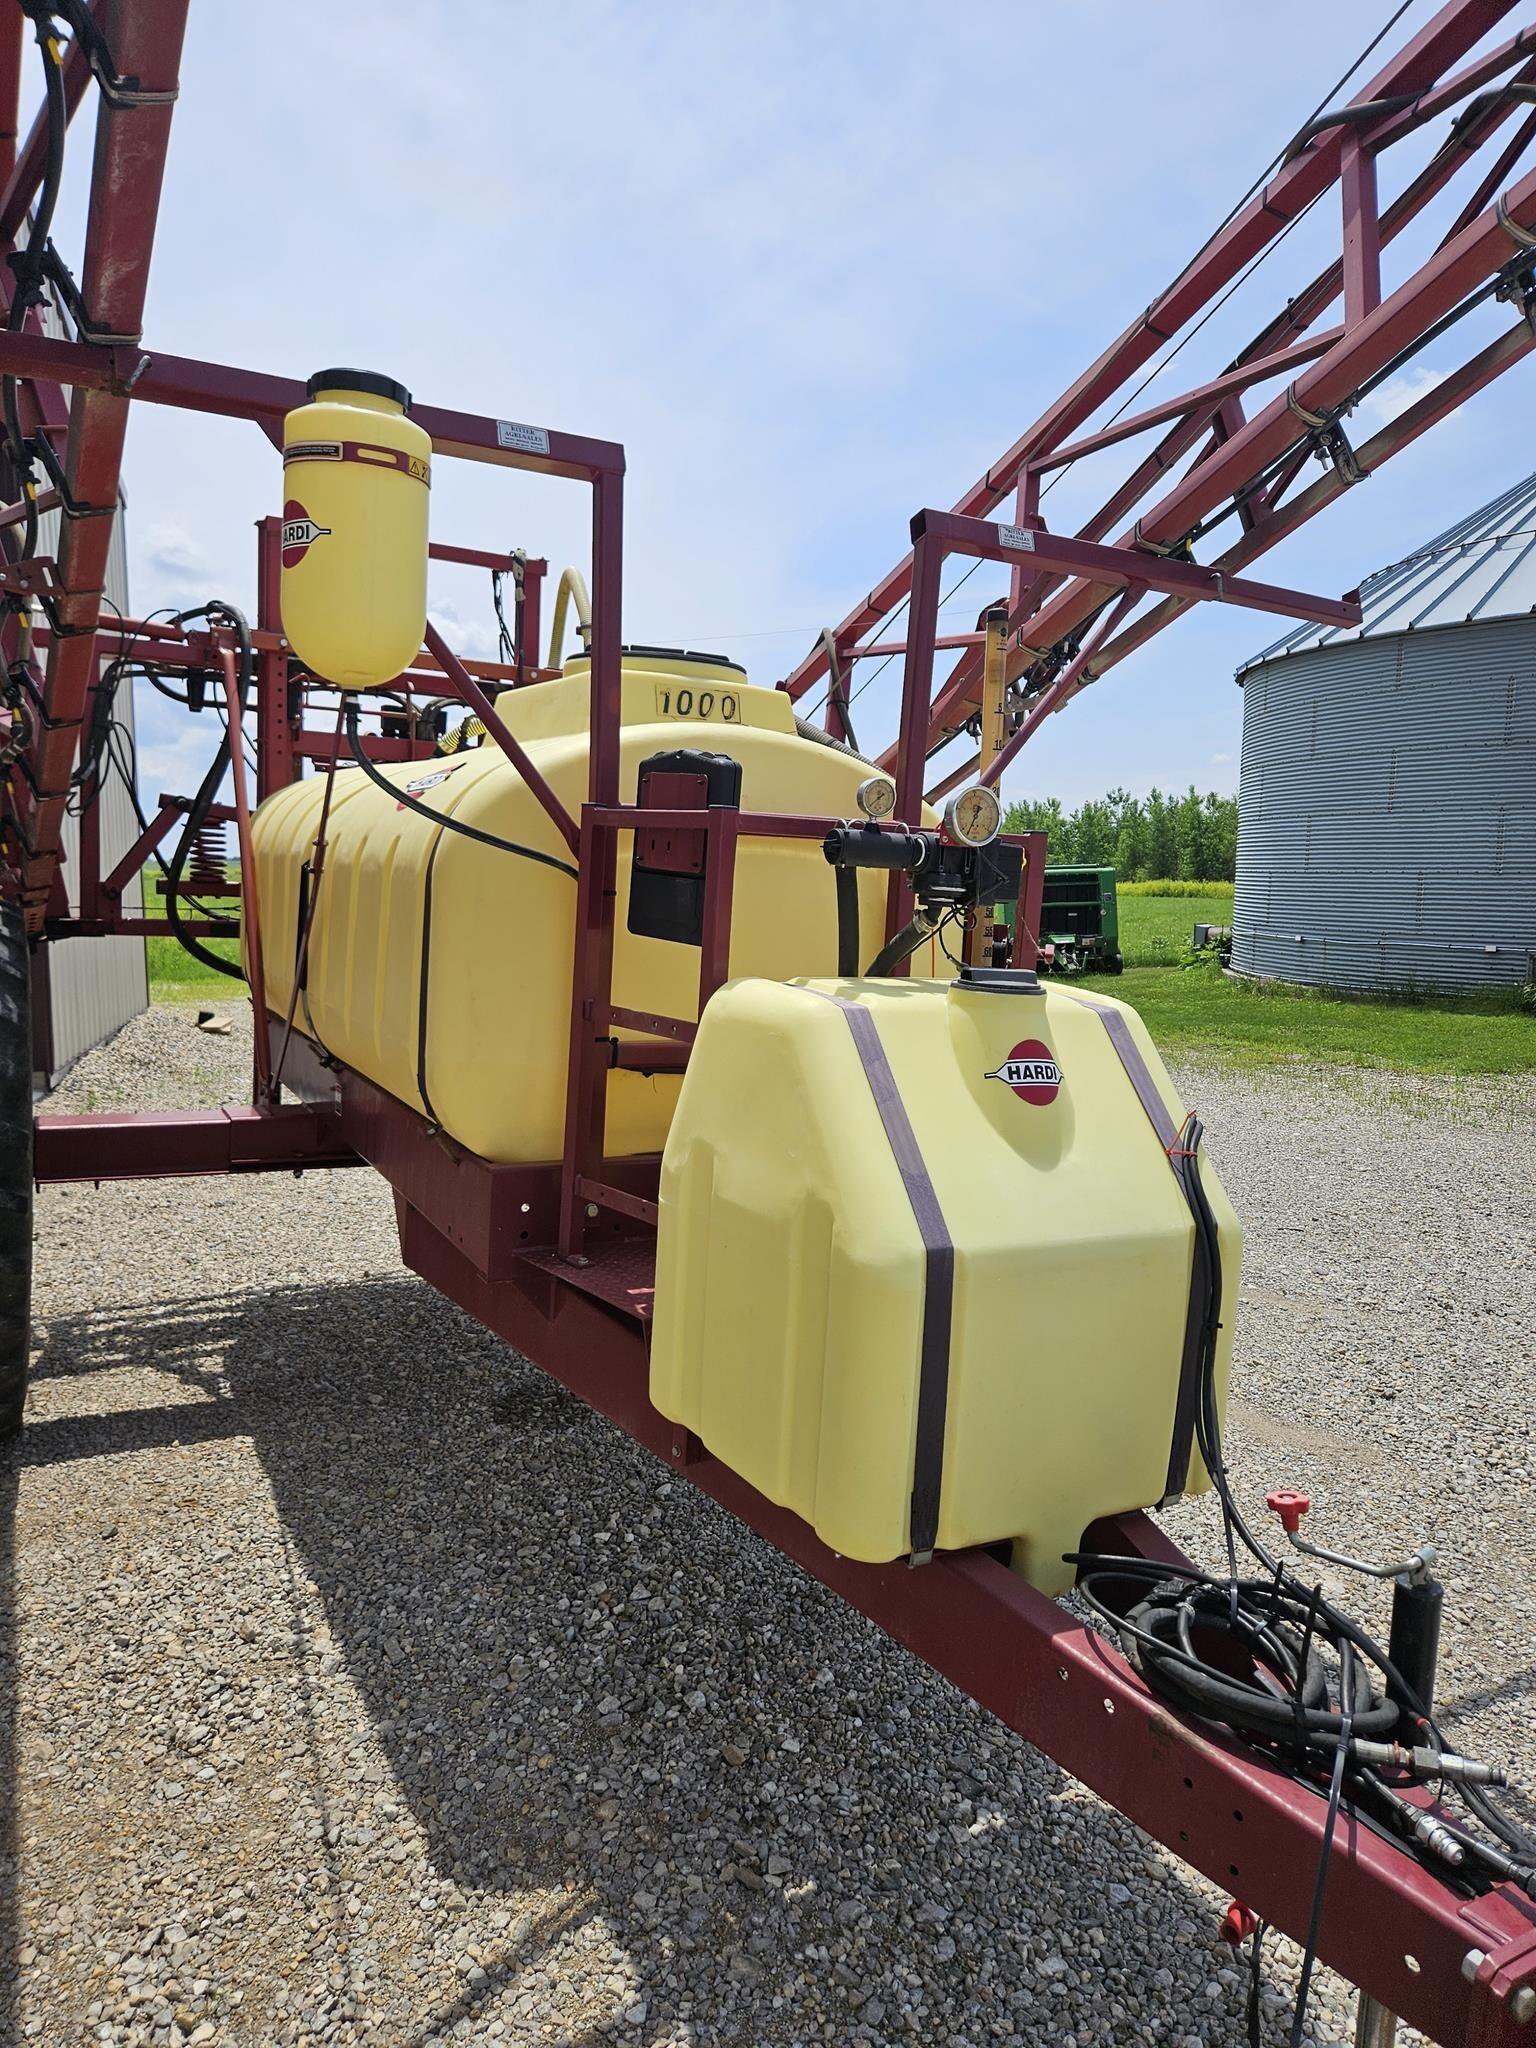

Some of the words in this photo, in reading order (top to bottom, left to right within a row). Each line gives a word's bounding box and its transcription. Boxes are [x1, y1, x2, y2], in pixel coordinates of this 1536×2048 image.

[283, 524, 310, 543] ARDI
[662, 690, 736, 720] 1000
[1007, 1064, 1058, 1081] HARDI
